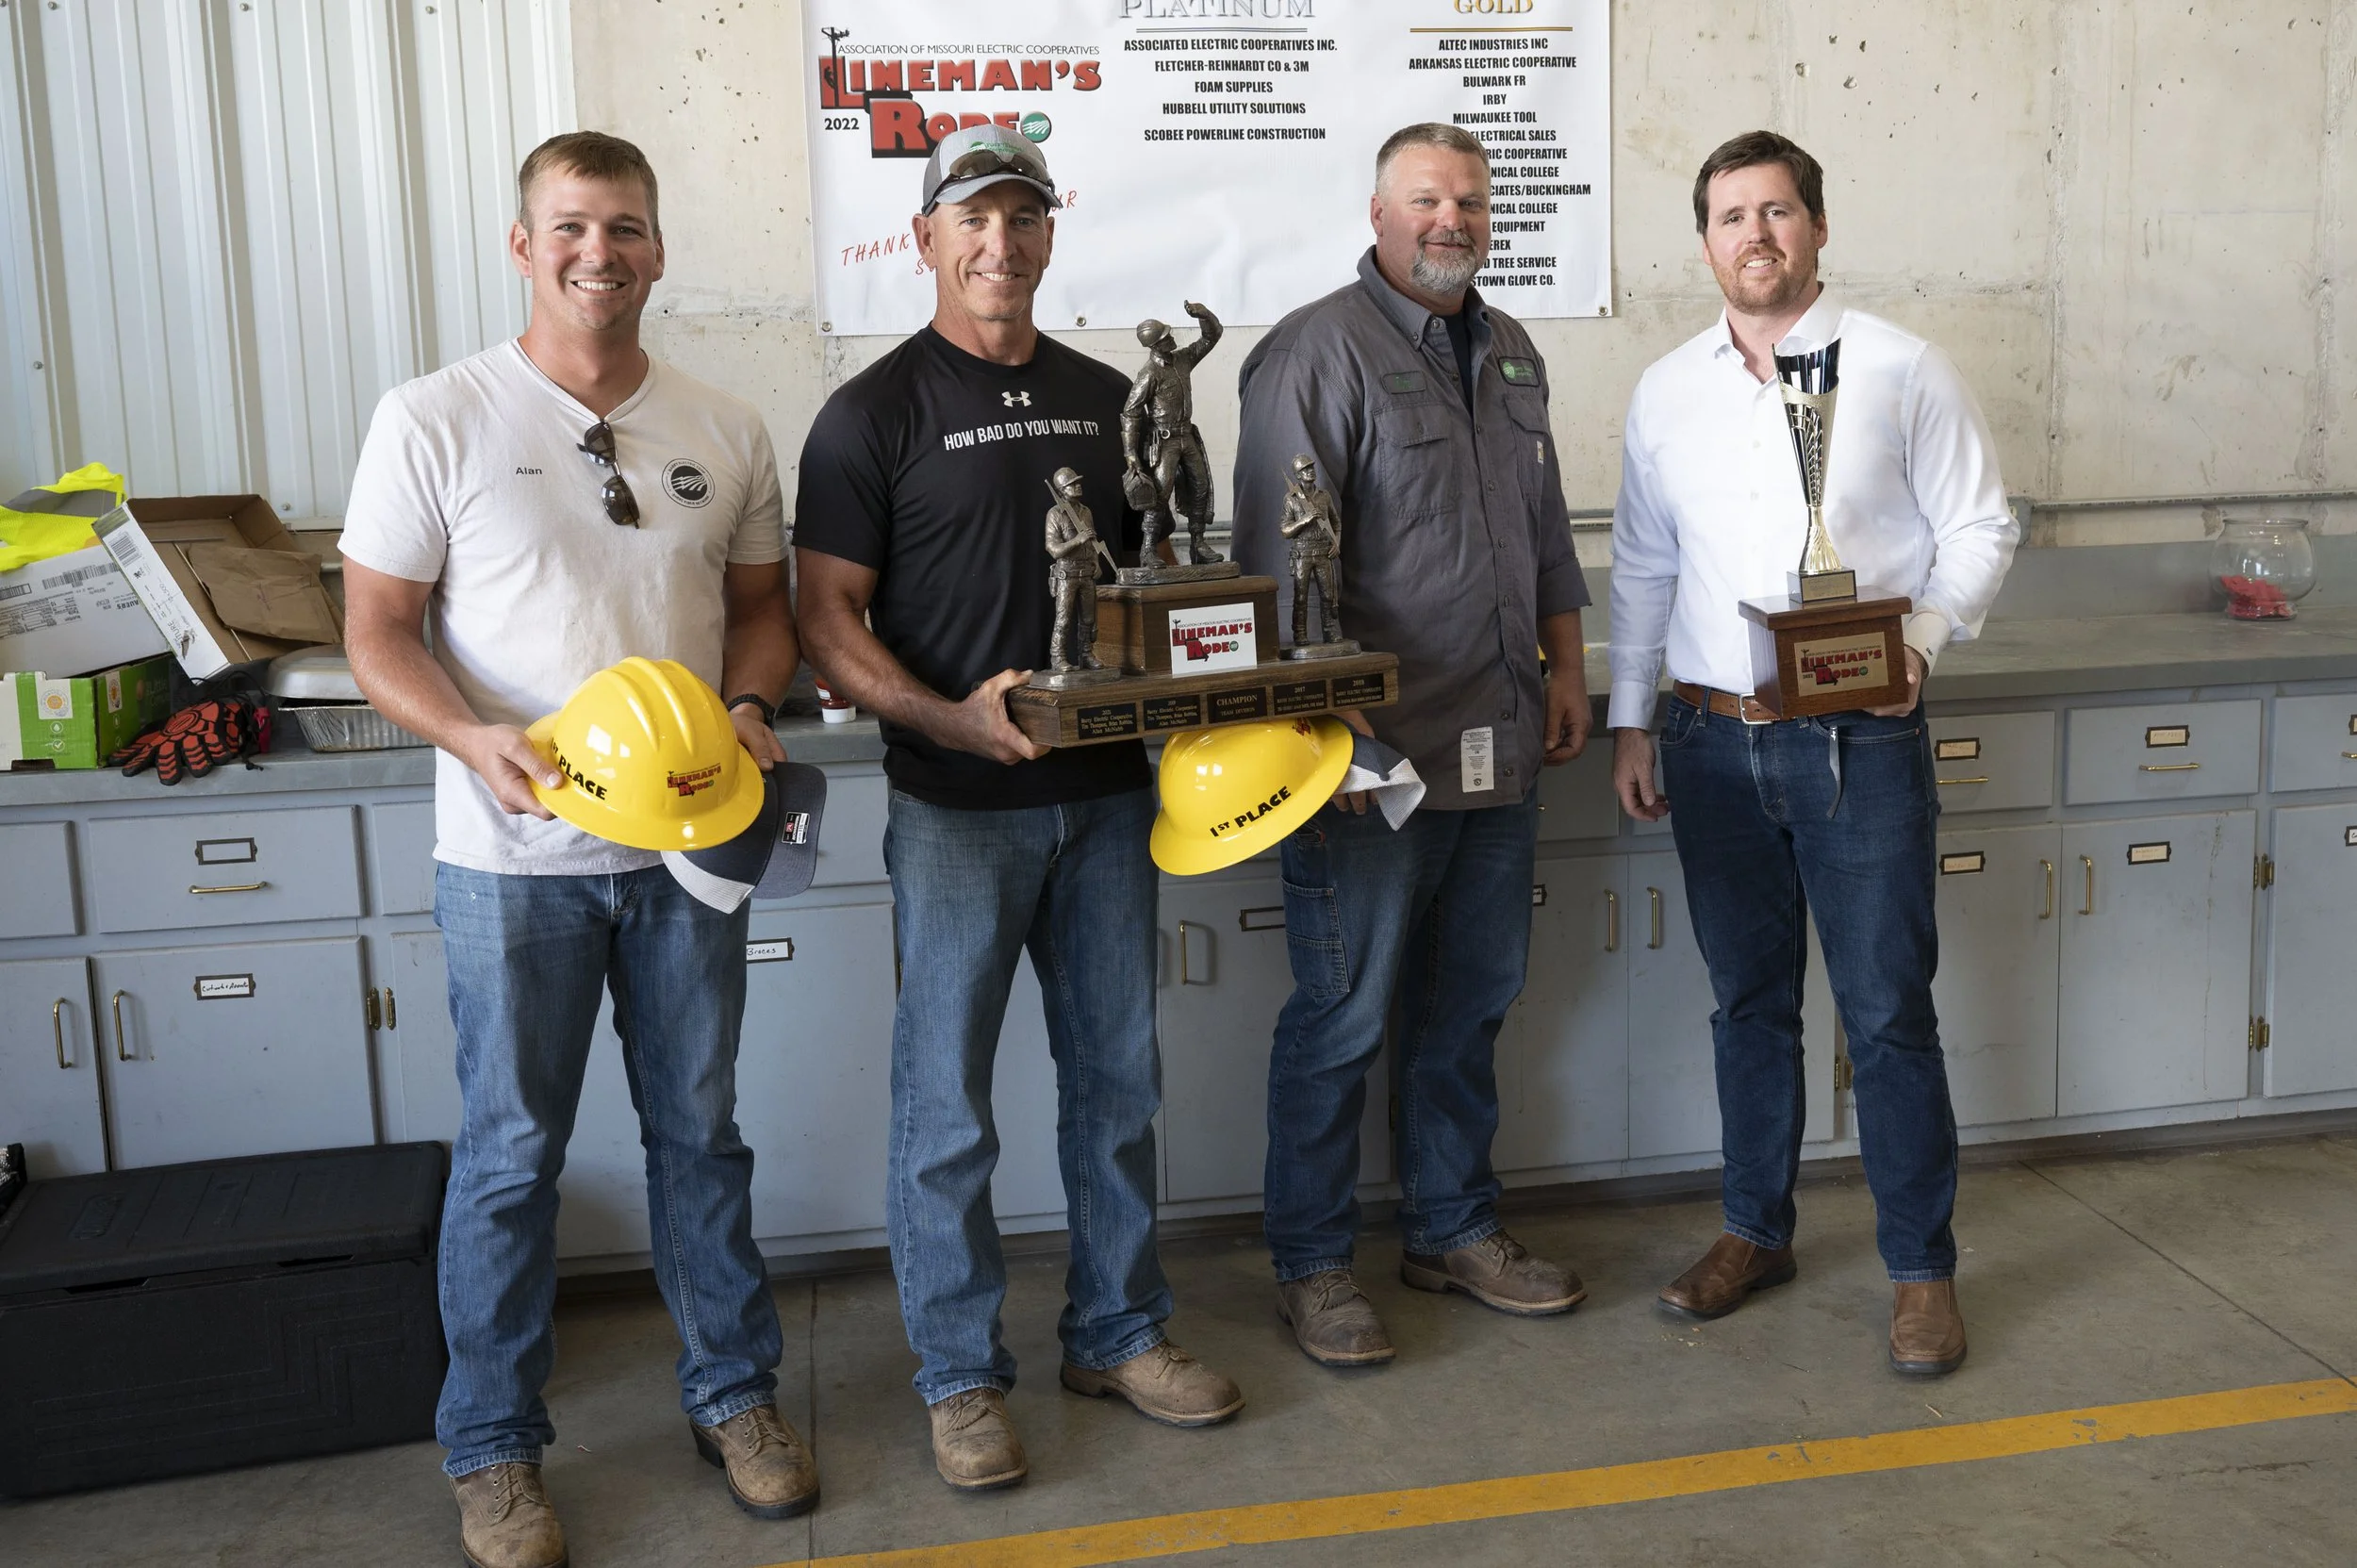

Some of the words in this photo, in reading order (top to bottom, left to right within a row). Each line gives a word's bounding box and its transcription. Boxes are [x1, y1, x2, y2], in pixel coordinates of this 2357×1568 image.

[1118, 0, 1316, 19] PLATINUM
[1453, 0, 1534, 14] GOLD
[838, 44, 908, 55] ASSOCIATION
[911, 44, 925, 54] OF
[928, 44, 974, 54] MISSOURI
[977, 44, 1023, 54] ELECTRIC
[1026, 44, 1100, 56] COOPERATIVES
[1124, 40, 1188, 51] ASSOCIATED
[1191, 39, 1239, 50] ELECTRIC
[1241, 39, 1314, 51] COOPERATIVES
[1317, 40, 1338, 51] INC.
[1439, 39, 1467, 51] ALTEC
[1469, 39, 1528, 51] INDUSTRIES
[1531, 38, 1548, 49] INC
[1155, 60, 1265, 72] FLETCHER-REINHARDT
[1268, 60, 1281, 72] CO
[1283, 63, 1292, 72] &
[1294, 61, 1310, 72] 3M
[1409, 58, 1462, 70] ARKANSAS
[1464, 58, 1509, 69] ELECTRIC
[1512, 57, 1577, 68] COOPERATIVE
[818, 55, 1102, 110] LINEMAN'S
[1195, 81, 1223, 92] FOAM
[1226, 81, 1273, 92] SUPPLIES
[1463, 75, 1511, 88] BULWARK
[1514, 75, 1525, 86] FR
[1483, 93, 1507, 106] IRBY
[1162, 103, 1208, 114] HUBBELL
[1210, 103, 1248, 114] UTILITY
[1250, 103, 1306, 114] SOLUTIONS
[1453, 112, 1511, 124] MILWAUKEE
[1513, 111, 1537, 123] TOOL
[824, 118, 860, 131] 2022
[1144, 129, 1184, 140] SCOBEE
[1186, 129, 1244, 140] POWERLINE
[1246, 128, 1326, 140] CONSTRUCTION
[1529, 130, 1557, 141] SALES
[1486, 148, 1502, 159] RIC
[1505, 148, 1567, 159] COOPERATIVE
[1491, 167, 1518, 178] NICAL
[1521, 166, 1559, 177] COLLEGE
[1490, 184, 1591, 196] CIATES/BUCKINGHAM
[1490, 203, 1516, 214] NICAL
[1519, 203, 1558, 214] COLLEGE
[1492, 221, 1545, 233] EQUIPMENT
[841, 233, 910, 267] THANK
[1490, 239, 1511, 251] EREX
[1492, 257, 1515, 269] TREE
[1517, 256, 1557, 268] SERVICE
[1473, 275, 1506, 287] STOWN
[1508, 275, 1538, 286] GLOVE
[1540, 274, 1556, 286] CO.
[944, 430, 975, 451] HOW
[977, 424, 1004, 444] BAD
[1005, 422, 1023, 439] DO
[1024, 420, 1050, 437] YOU
[1050, 419, 1083, 435] WANT
[1083, 421, 1099, 437] IT?
[515, 467, 543, 475] Alan
[1172, 622, 1253, 647] LINEMAN'S
[1216, 694, 1258, 706] CHAMPION
[558, 754, 607, 801] PLACE
[1210, 821, 1230, 837] 1ST
[1234, 785, 1292, 828] PLACE
